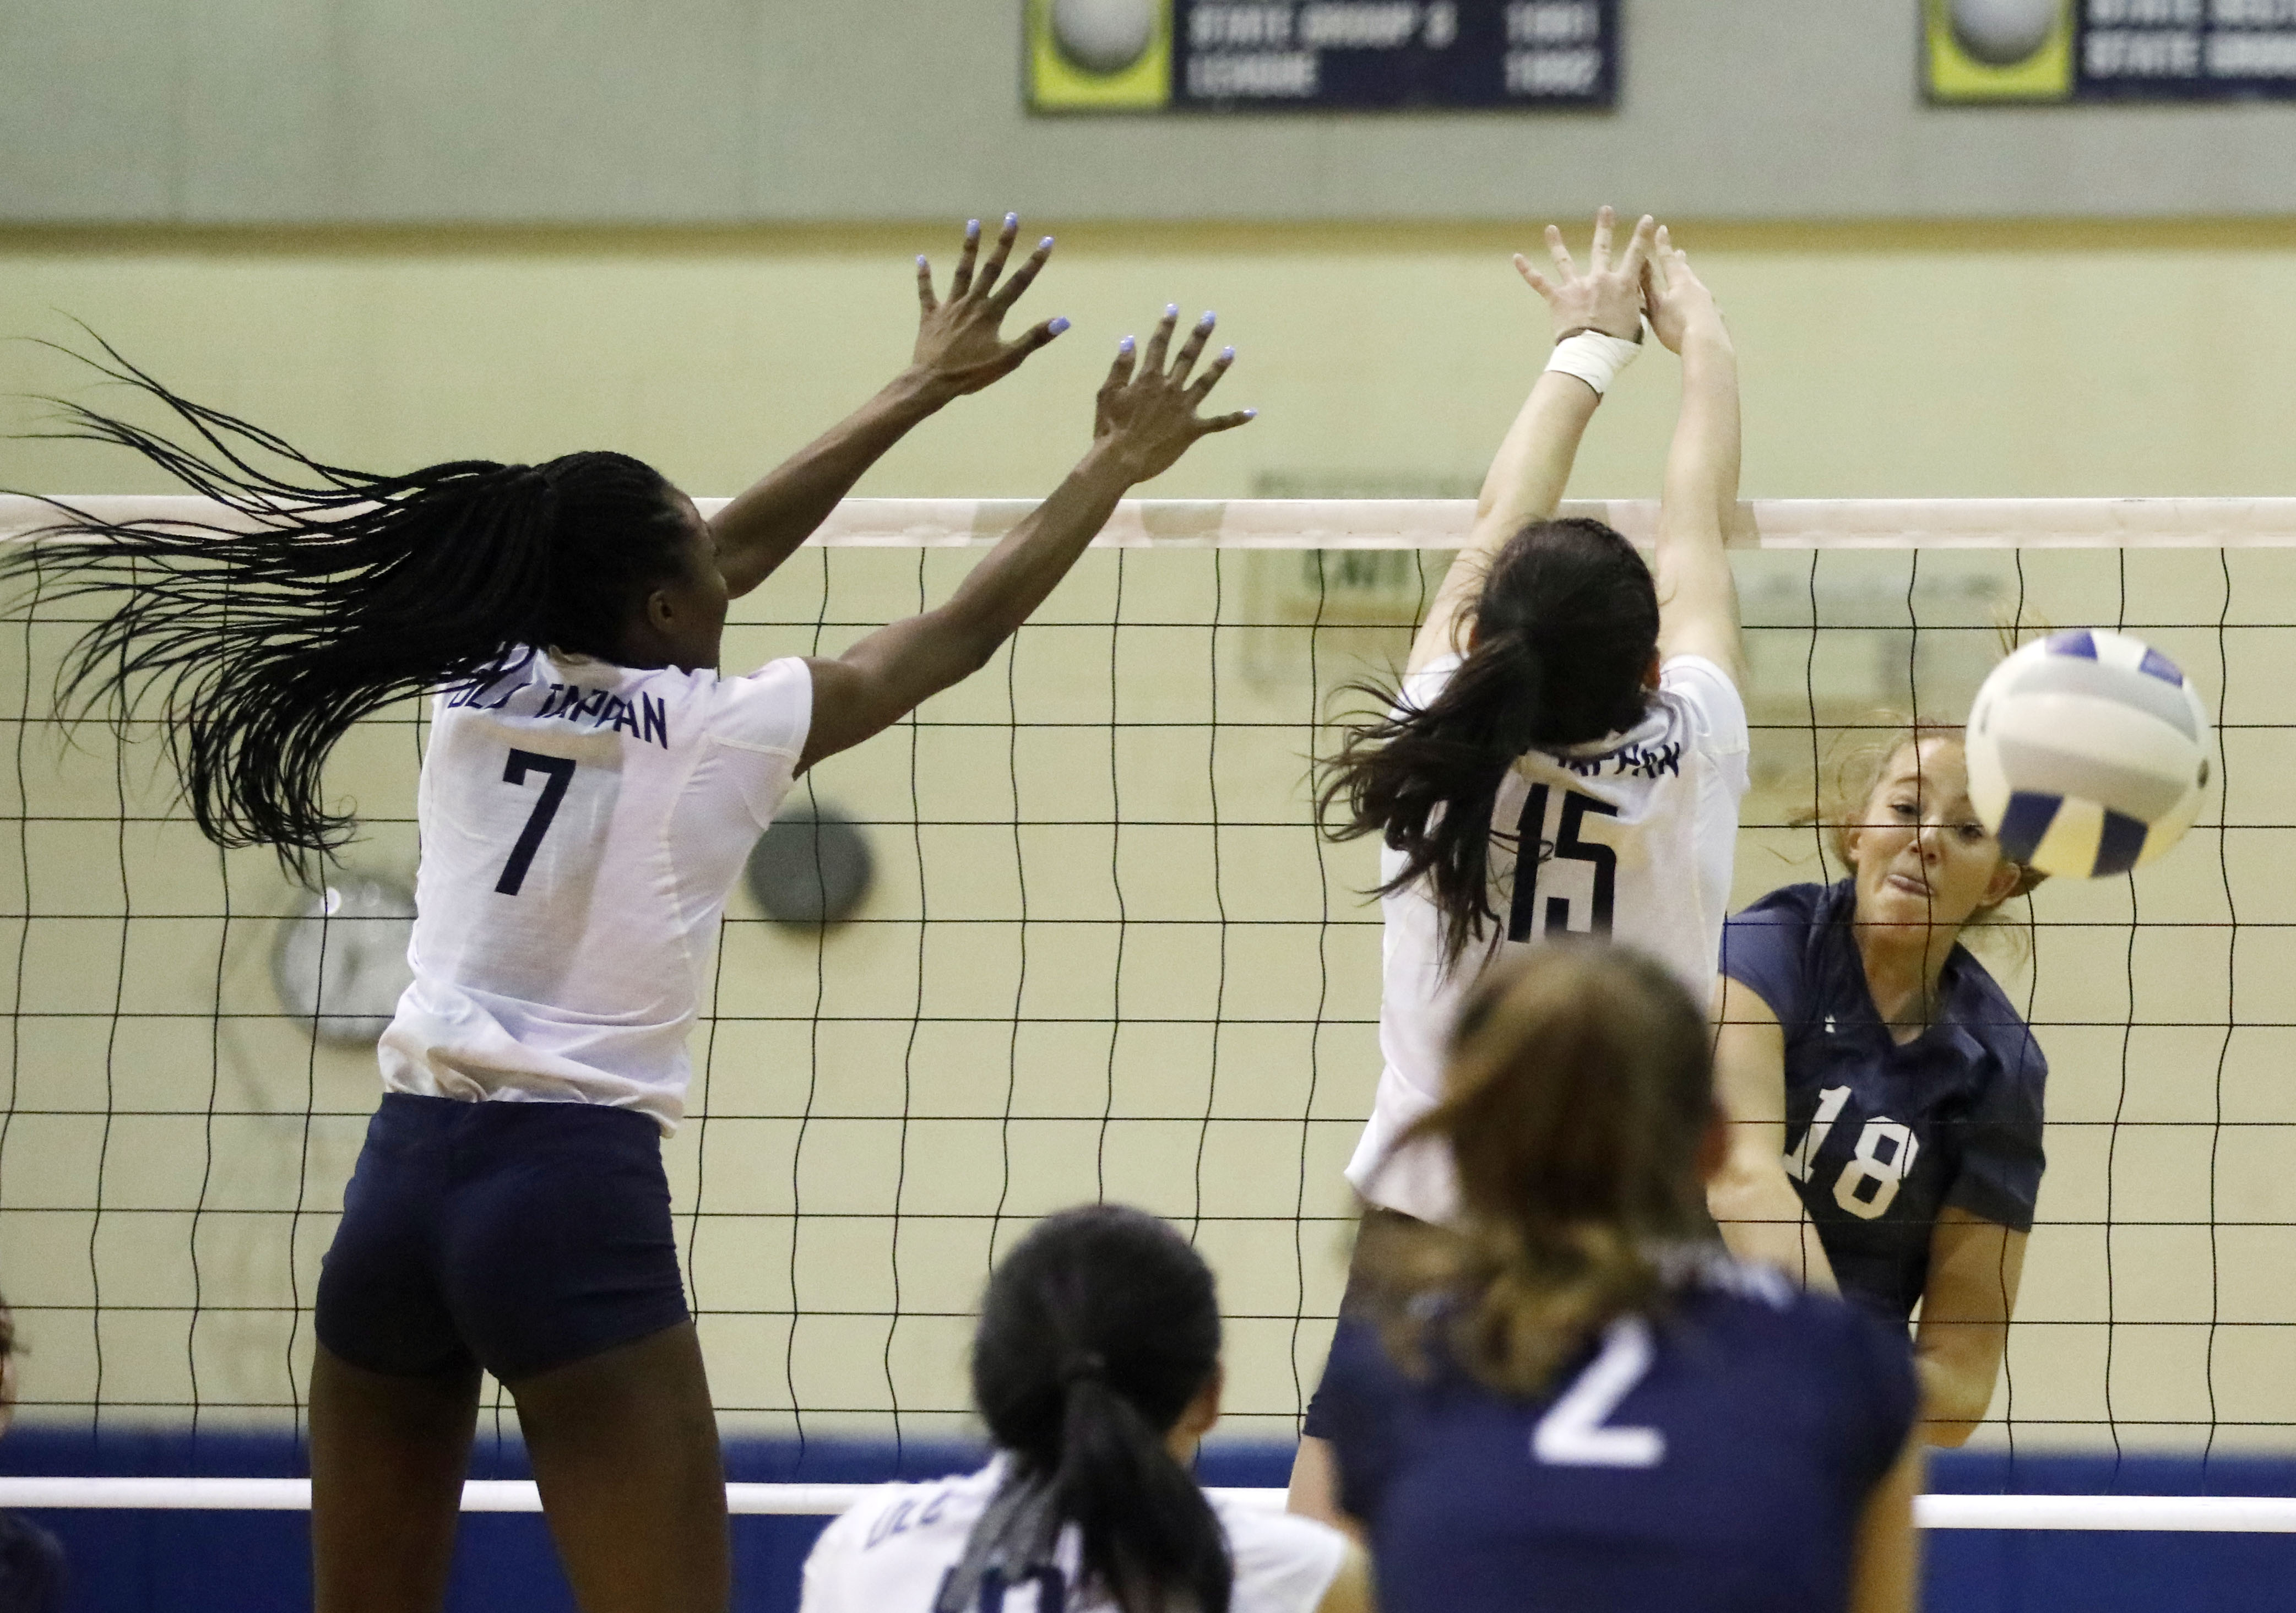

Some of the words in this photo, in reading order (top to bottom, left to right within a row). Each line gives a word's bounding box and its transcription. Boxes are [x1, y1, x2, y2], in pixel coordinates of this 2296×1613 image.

[494, 748, 576, 895] 7
[1507, 783, 1617, 943] 15
[1783, 1085, 1920, 1220] 18
[1531, 1315, 1665, 1467] 2
